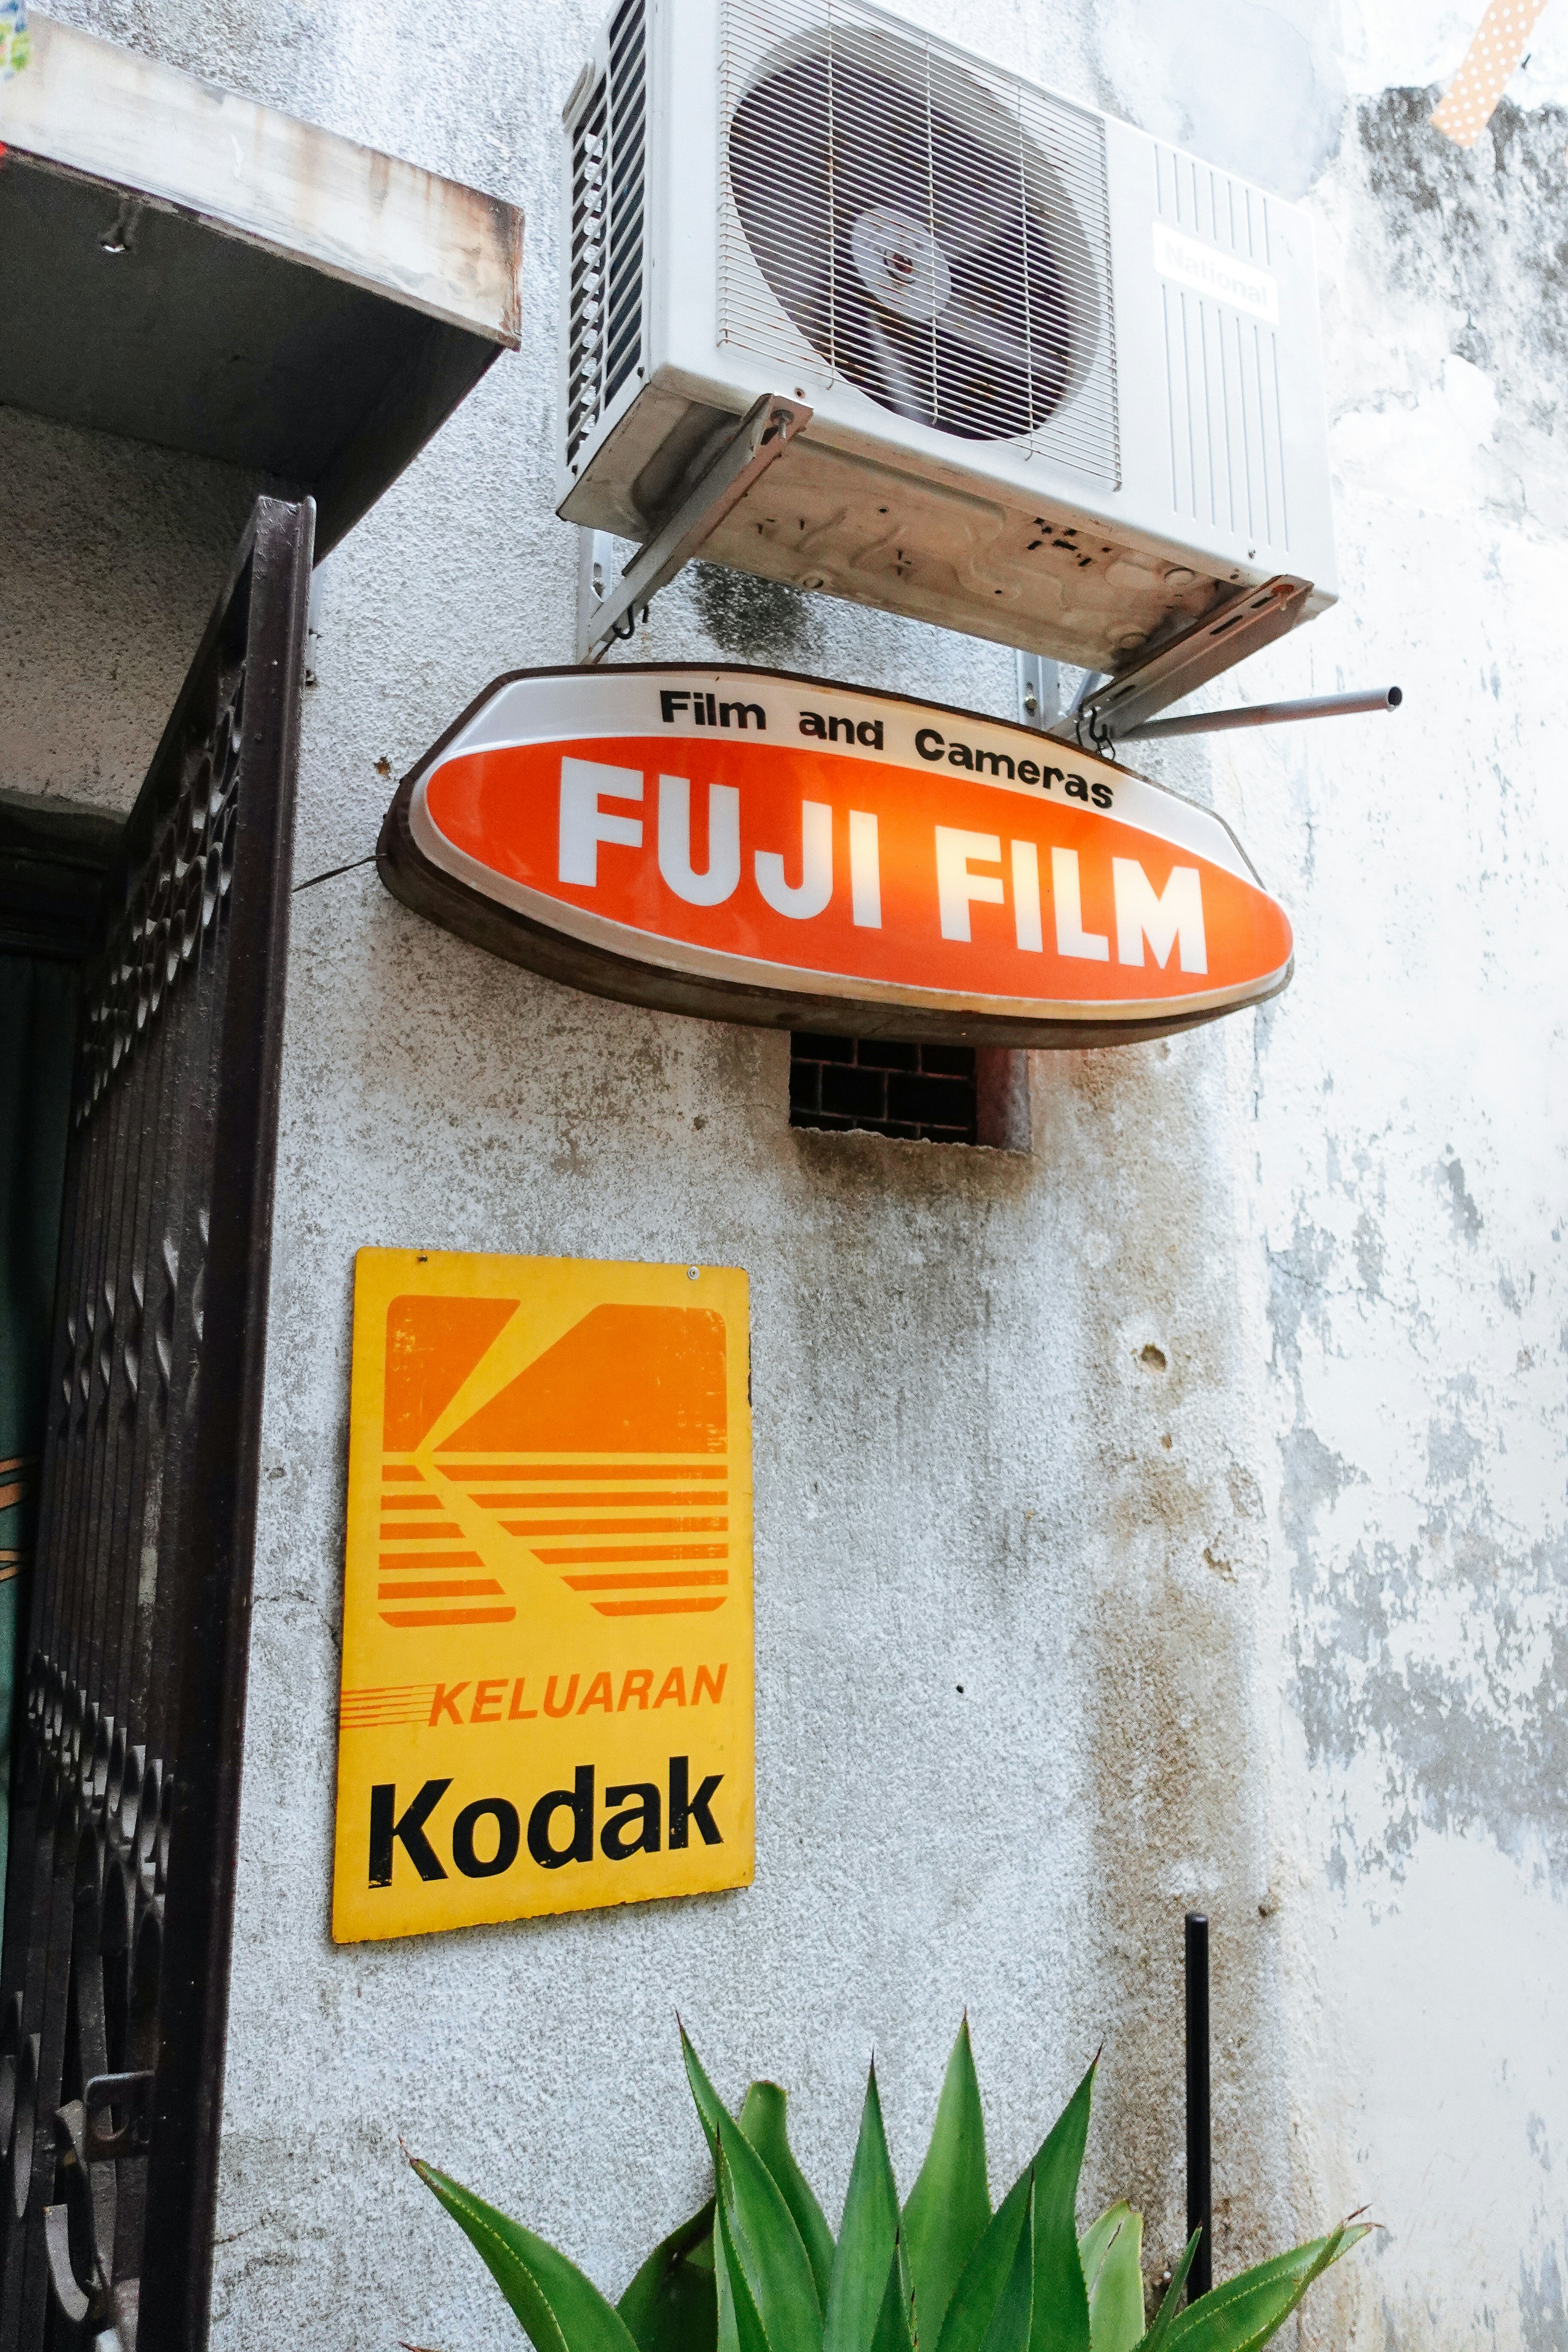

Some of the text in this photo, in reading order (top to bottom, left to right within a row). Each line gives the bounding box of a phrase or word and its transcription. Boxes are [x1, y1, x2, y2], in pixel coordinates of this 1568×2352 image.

[1164, 242, 1267, 307] National
[659, 690, 1113, 809] Film and Cameras
[558, 756, 1208, 975] FUJI FILM
[429, 1663, 728, 1727] KELUARAN
[368, 1755, 725, 1890] Kodak
